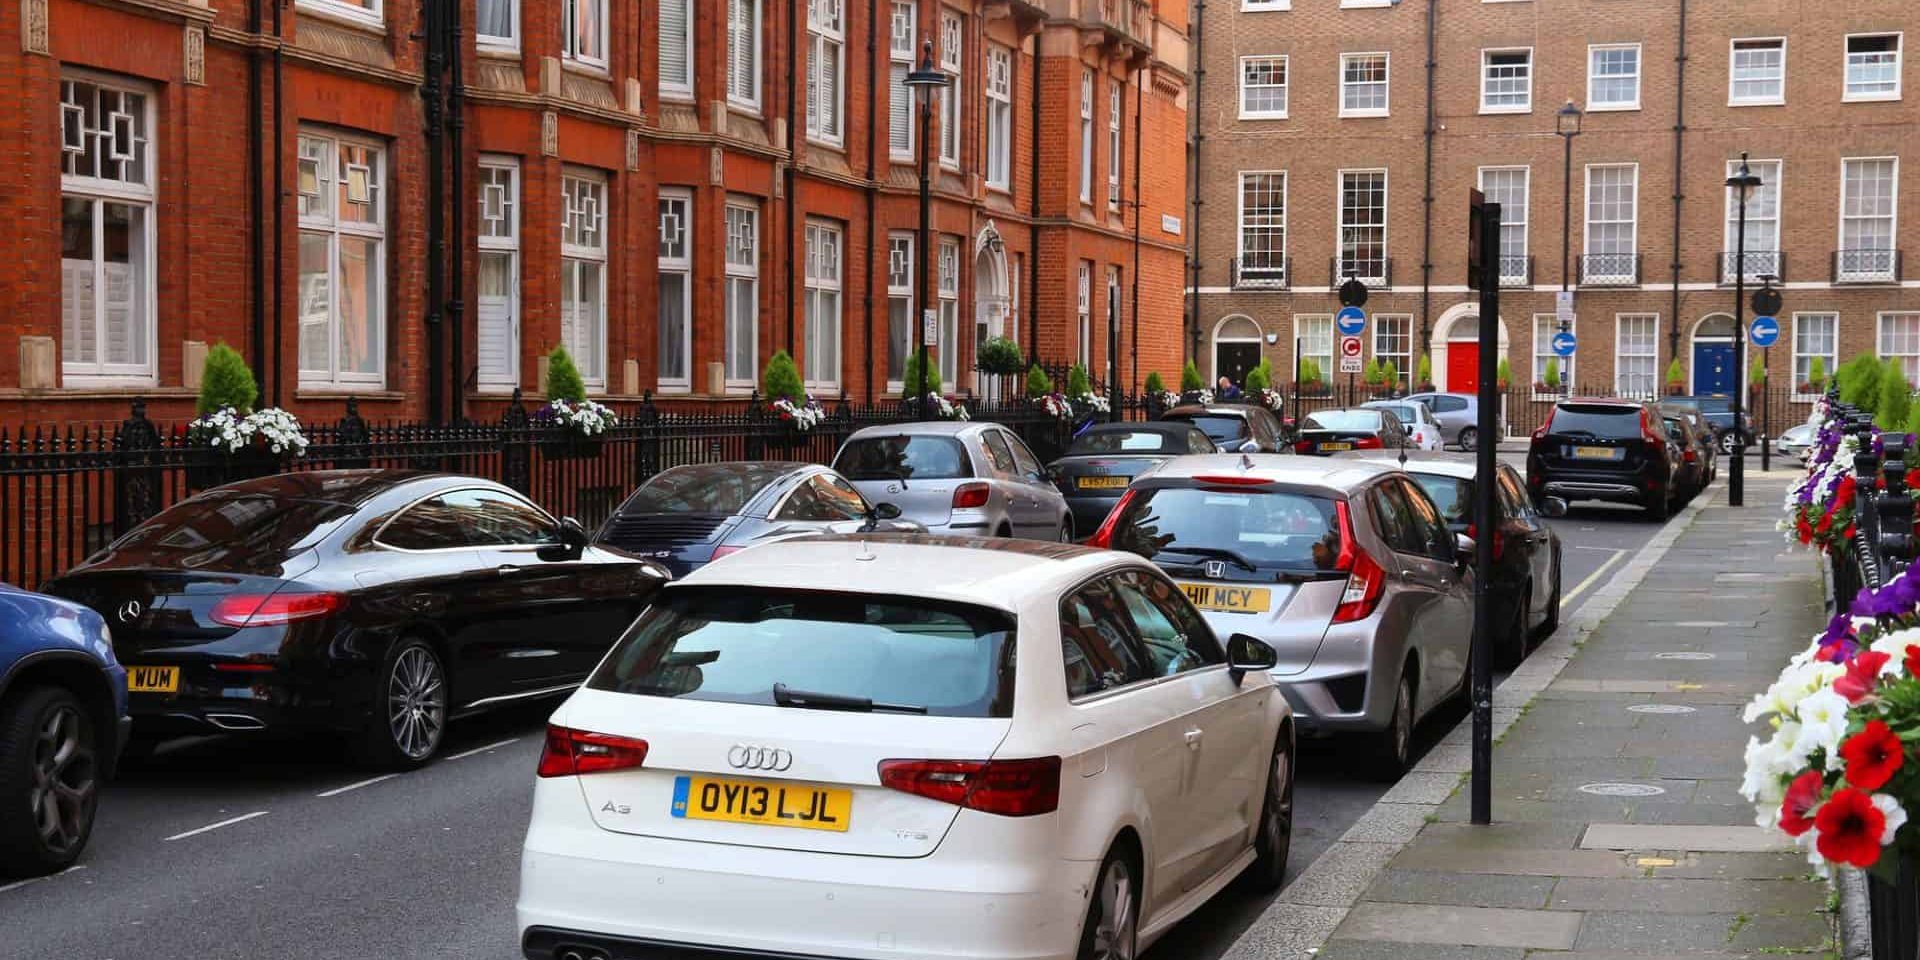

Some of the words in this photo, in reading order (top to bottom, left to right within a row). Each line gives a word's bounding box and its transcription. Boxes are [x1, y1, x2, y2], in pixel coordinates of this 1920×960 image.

[1214, 588, 1251, 607] MCY
[135, 668, 171, 687] WUM
[600, 800, 632, 814] A3
[700, 782, 769, 816] OY13
[776, 788, 837, 823] LJL
